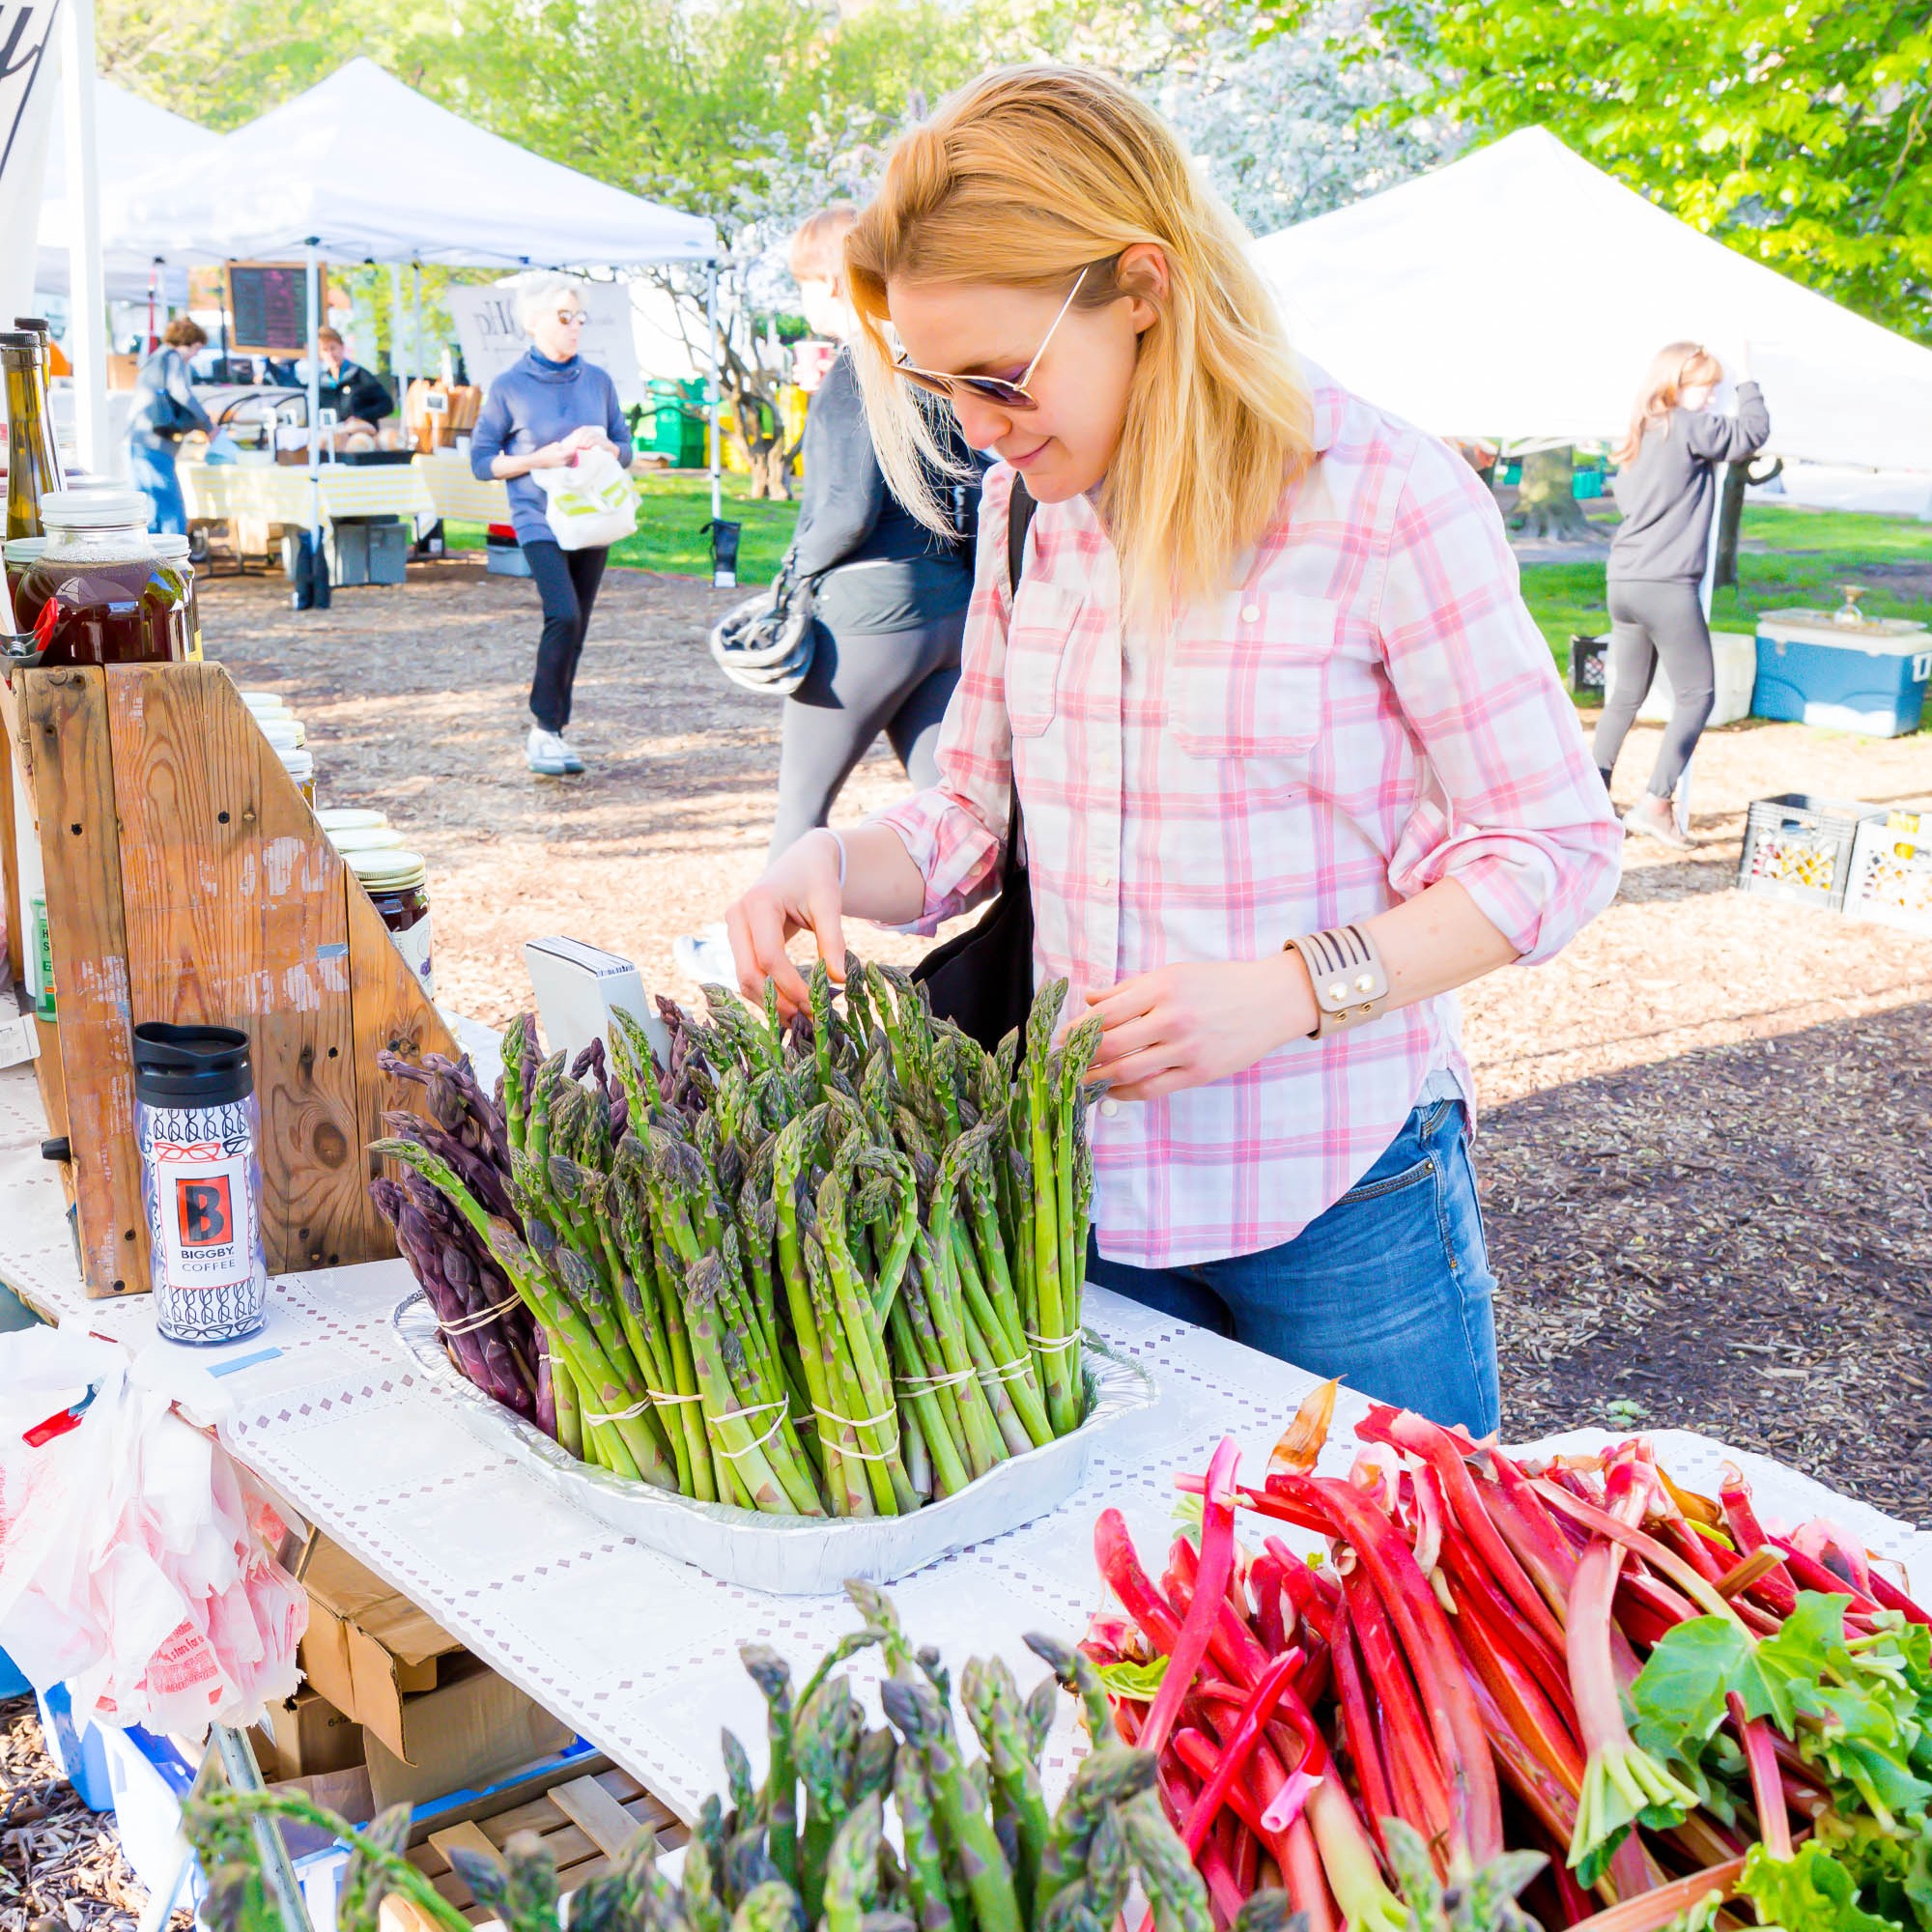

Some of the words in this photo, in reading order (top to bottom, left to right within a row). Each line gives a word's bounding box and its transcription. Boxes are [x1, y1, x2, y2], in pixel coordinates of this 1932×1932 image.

[185, 1185, 224, 1241] B
[181, 1246, 234, 1259] BIGGBY
[182, 1260, 236, 1272] COFFEE
